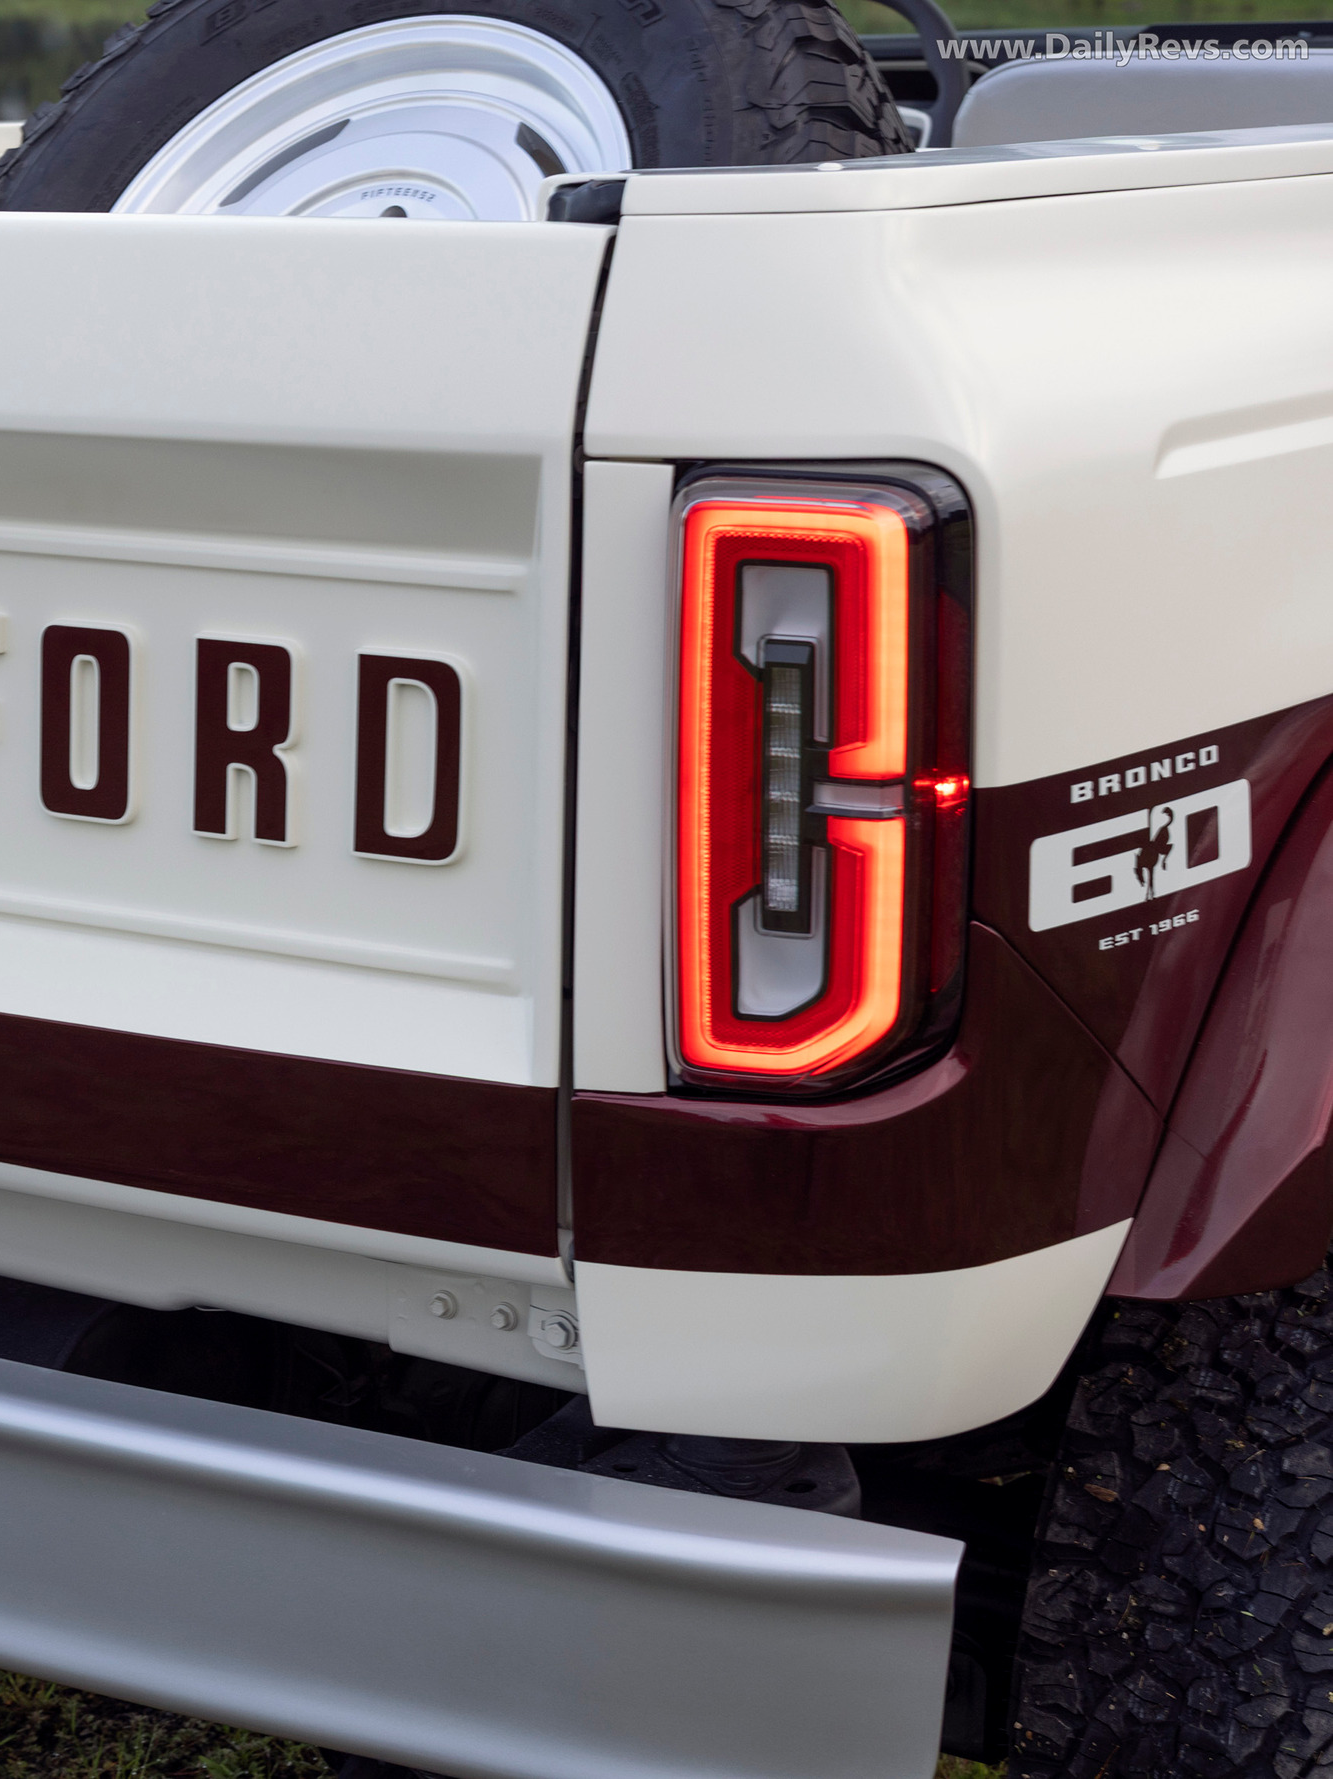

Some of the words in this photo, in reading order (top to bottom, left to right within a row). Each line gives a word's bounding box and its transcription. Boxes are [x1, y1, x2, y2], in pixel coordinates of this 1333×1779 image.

[1070, 744, 1219, 804] BRONCO
[1028, 778, 1252, 932] 60
[1098, 928, 1144, 951] EST
[1149, 909, 1200, 936] 1966
